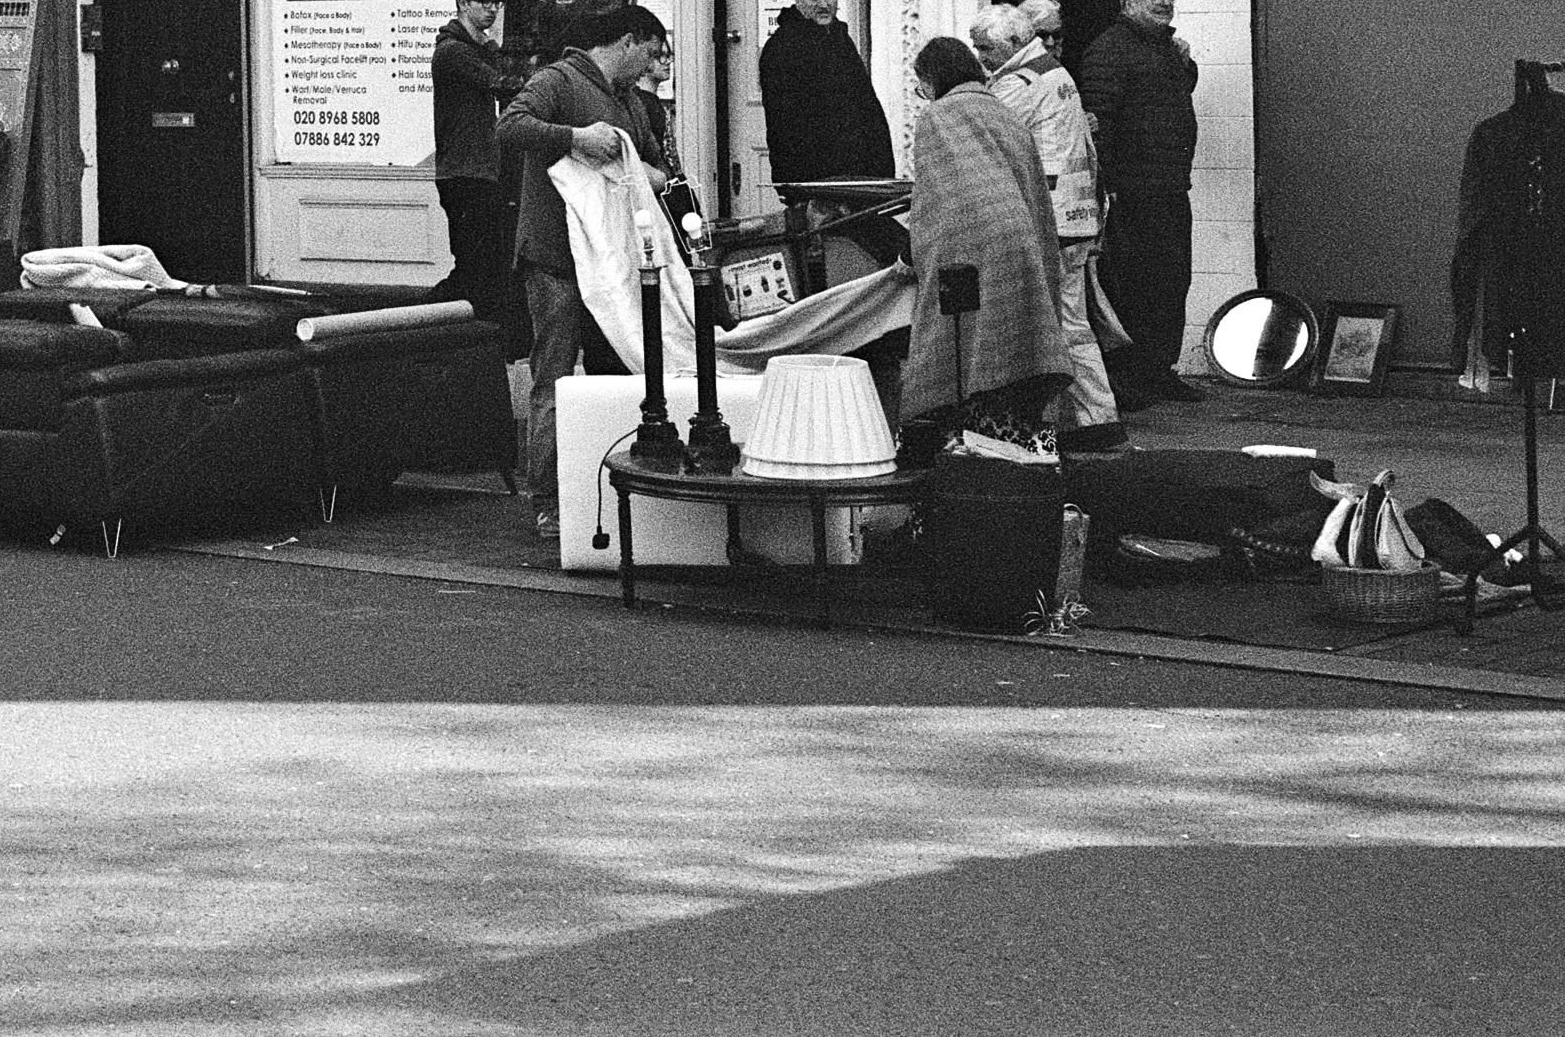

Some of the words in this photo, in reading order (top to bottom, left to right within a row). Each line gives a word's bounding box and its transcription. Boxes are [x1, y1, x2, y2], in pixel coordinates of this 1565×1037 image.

[290, 10, 311, 19] Botox
[397, 9, 423, 18] Tattoo
[425, 9, 459, 19] Remova
[290, 25, 308, 34] Filler
[329, 26, 344, 35] Body
[397, 24, 419, 33] Laser
[291, 40, 341, 51] Mesotherapy
[291, 54, 339, 66] Non-Surgical
[340, 54, 367, 64] Facelift
[291, 69, 318, 81] Weight
[319, 69, 335, 79] loss
[336, 69, 357, 79] clinic
[397, 69, 414, 79] Hair
[398, 83, 416, 93] and
[293, 95, 328, 104] Removal
[294, 110, 316, 125] 020
[318, 110, 348, 125] 8968
[351, 111, 380, 126] 5808
[294, 131, 330, 146] 07886
[333, 132, 355, 146] 842
[358, 132, 381, 147] 329
